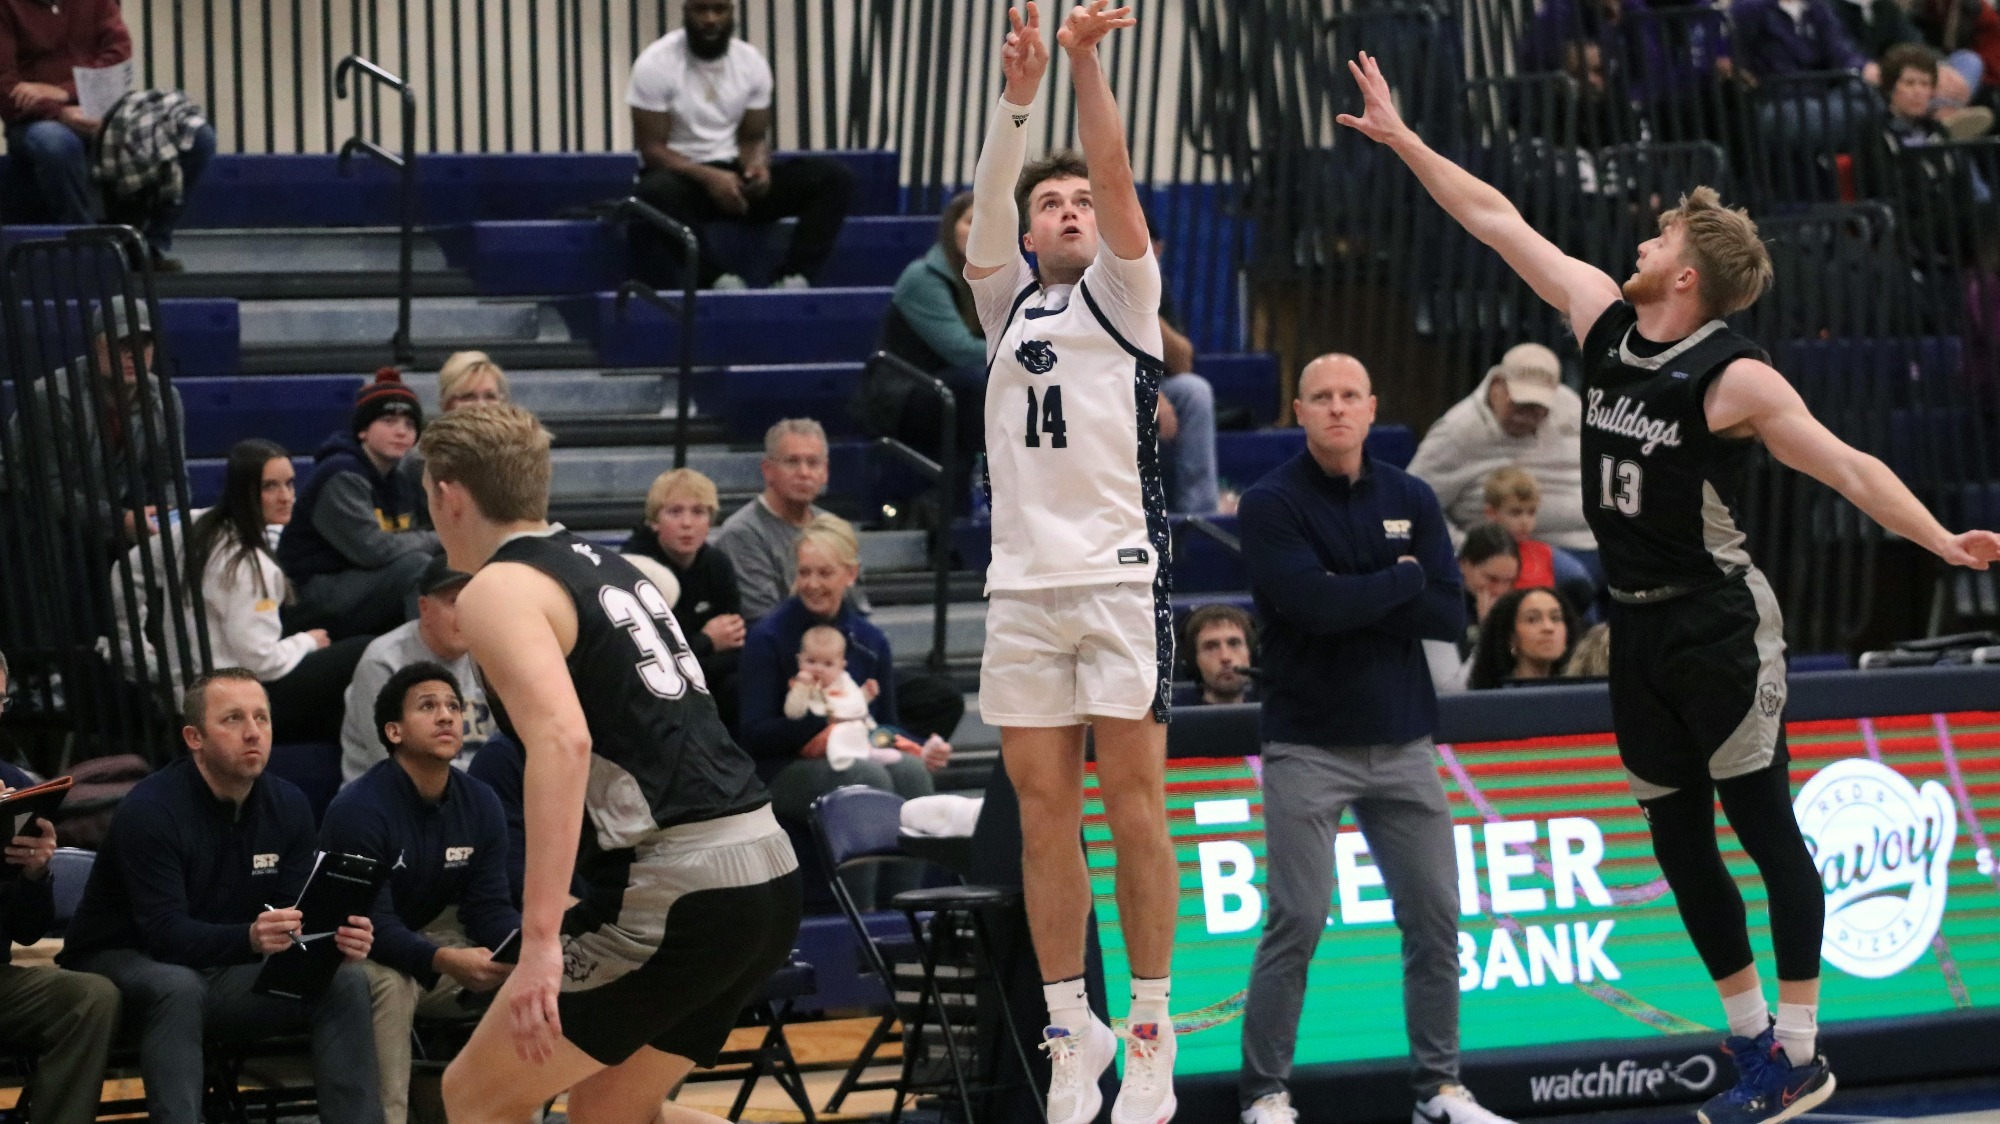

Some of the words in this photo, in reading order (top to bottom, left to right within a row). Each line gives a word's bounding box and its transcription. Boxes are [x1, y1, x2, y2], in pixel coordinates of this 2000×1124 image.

[1025, 385, 1067, 448] 14
[1586, 386, 1682, 456] Bulldogs
[1599, 454, 1643, 518] 13
[598, 580, 710, 700] 33
[1198, 816, 1613, 935] BEER
[1803, 816, 1934, 894] avoy
[1458, 920, 1622, 992] BANK
[1529, 1060, 1666, 1103] watchfire
